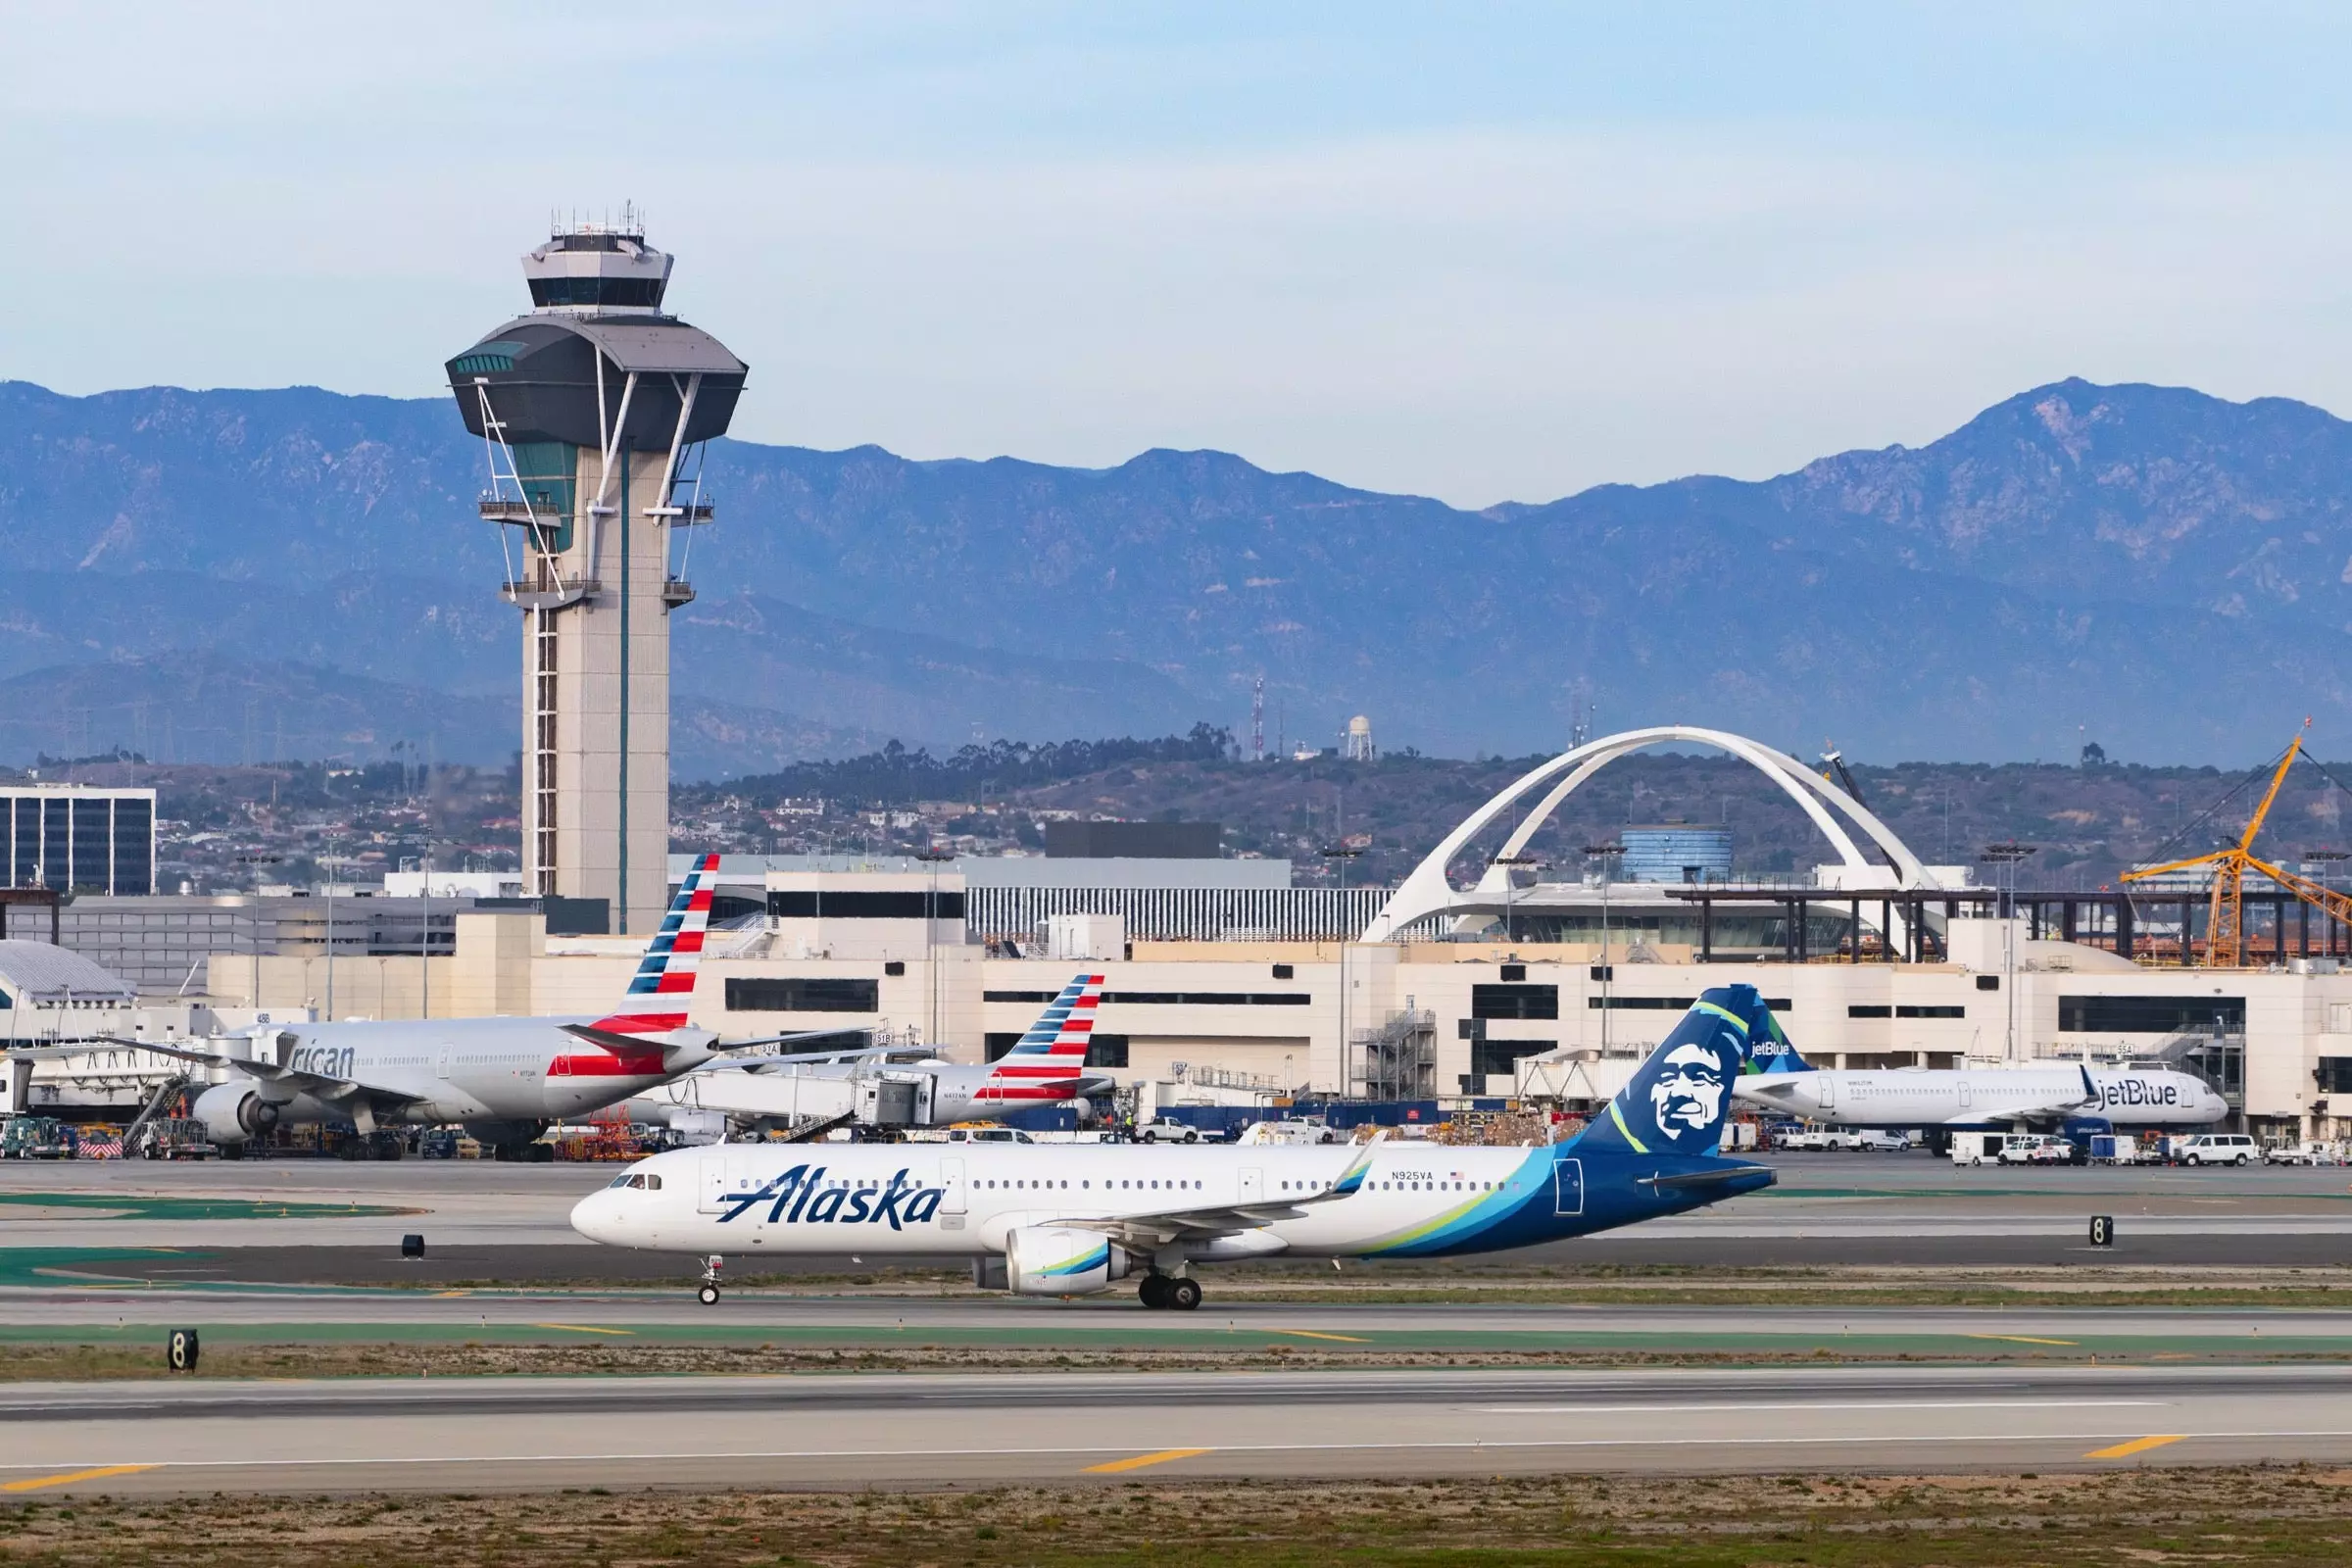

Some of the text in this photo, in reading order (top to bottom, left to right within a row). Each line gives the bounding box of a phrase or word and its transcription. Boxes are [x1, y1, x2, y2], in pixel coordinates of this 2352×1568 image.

[876, 1034, 891, 1043] 51B
[1751, 1041, 1789, 1058] jetBlue
[2098, 1079, 2177, 1112] jetBlue
[1392, 1171, 1433, 1181] N925VA
[716, 1164, 947, 1232] Alaska
[2093, 1217, 2104, 1244] 8
[172, 1332, 185, 1368] 8
